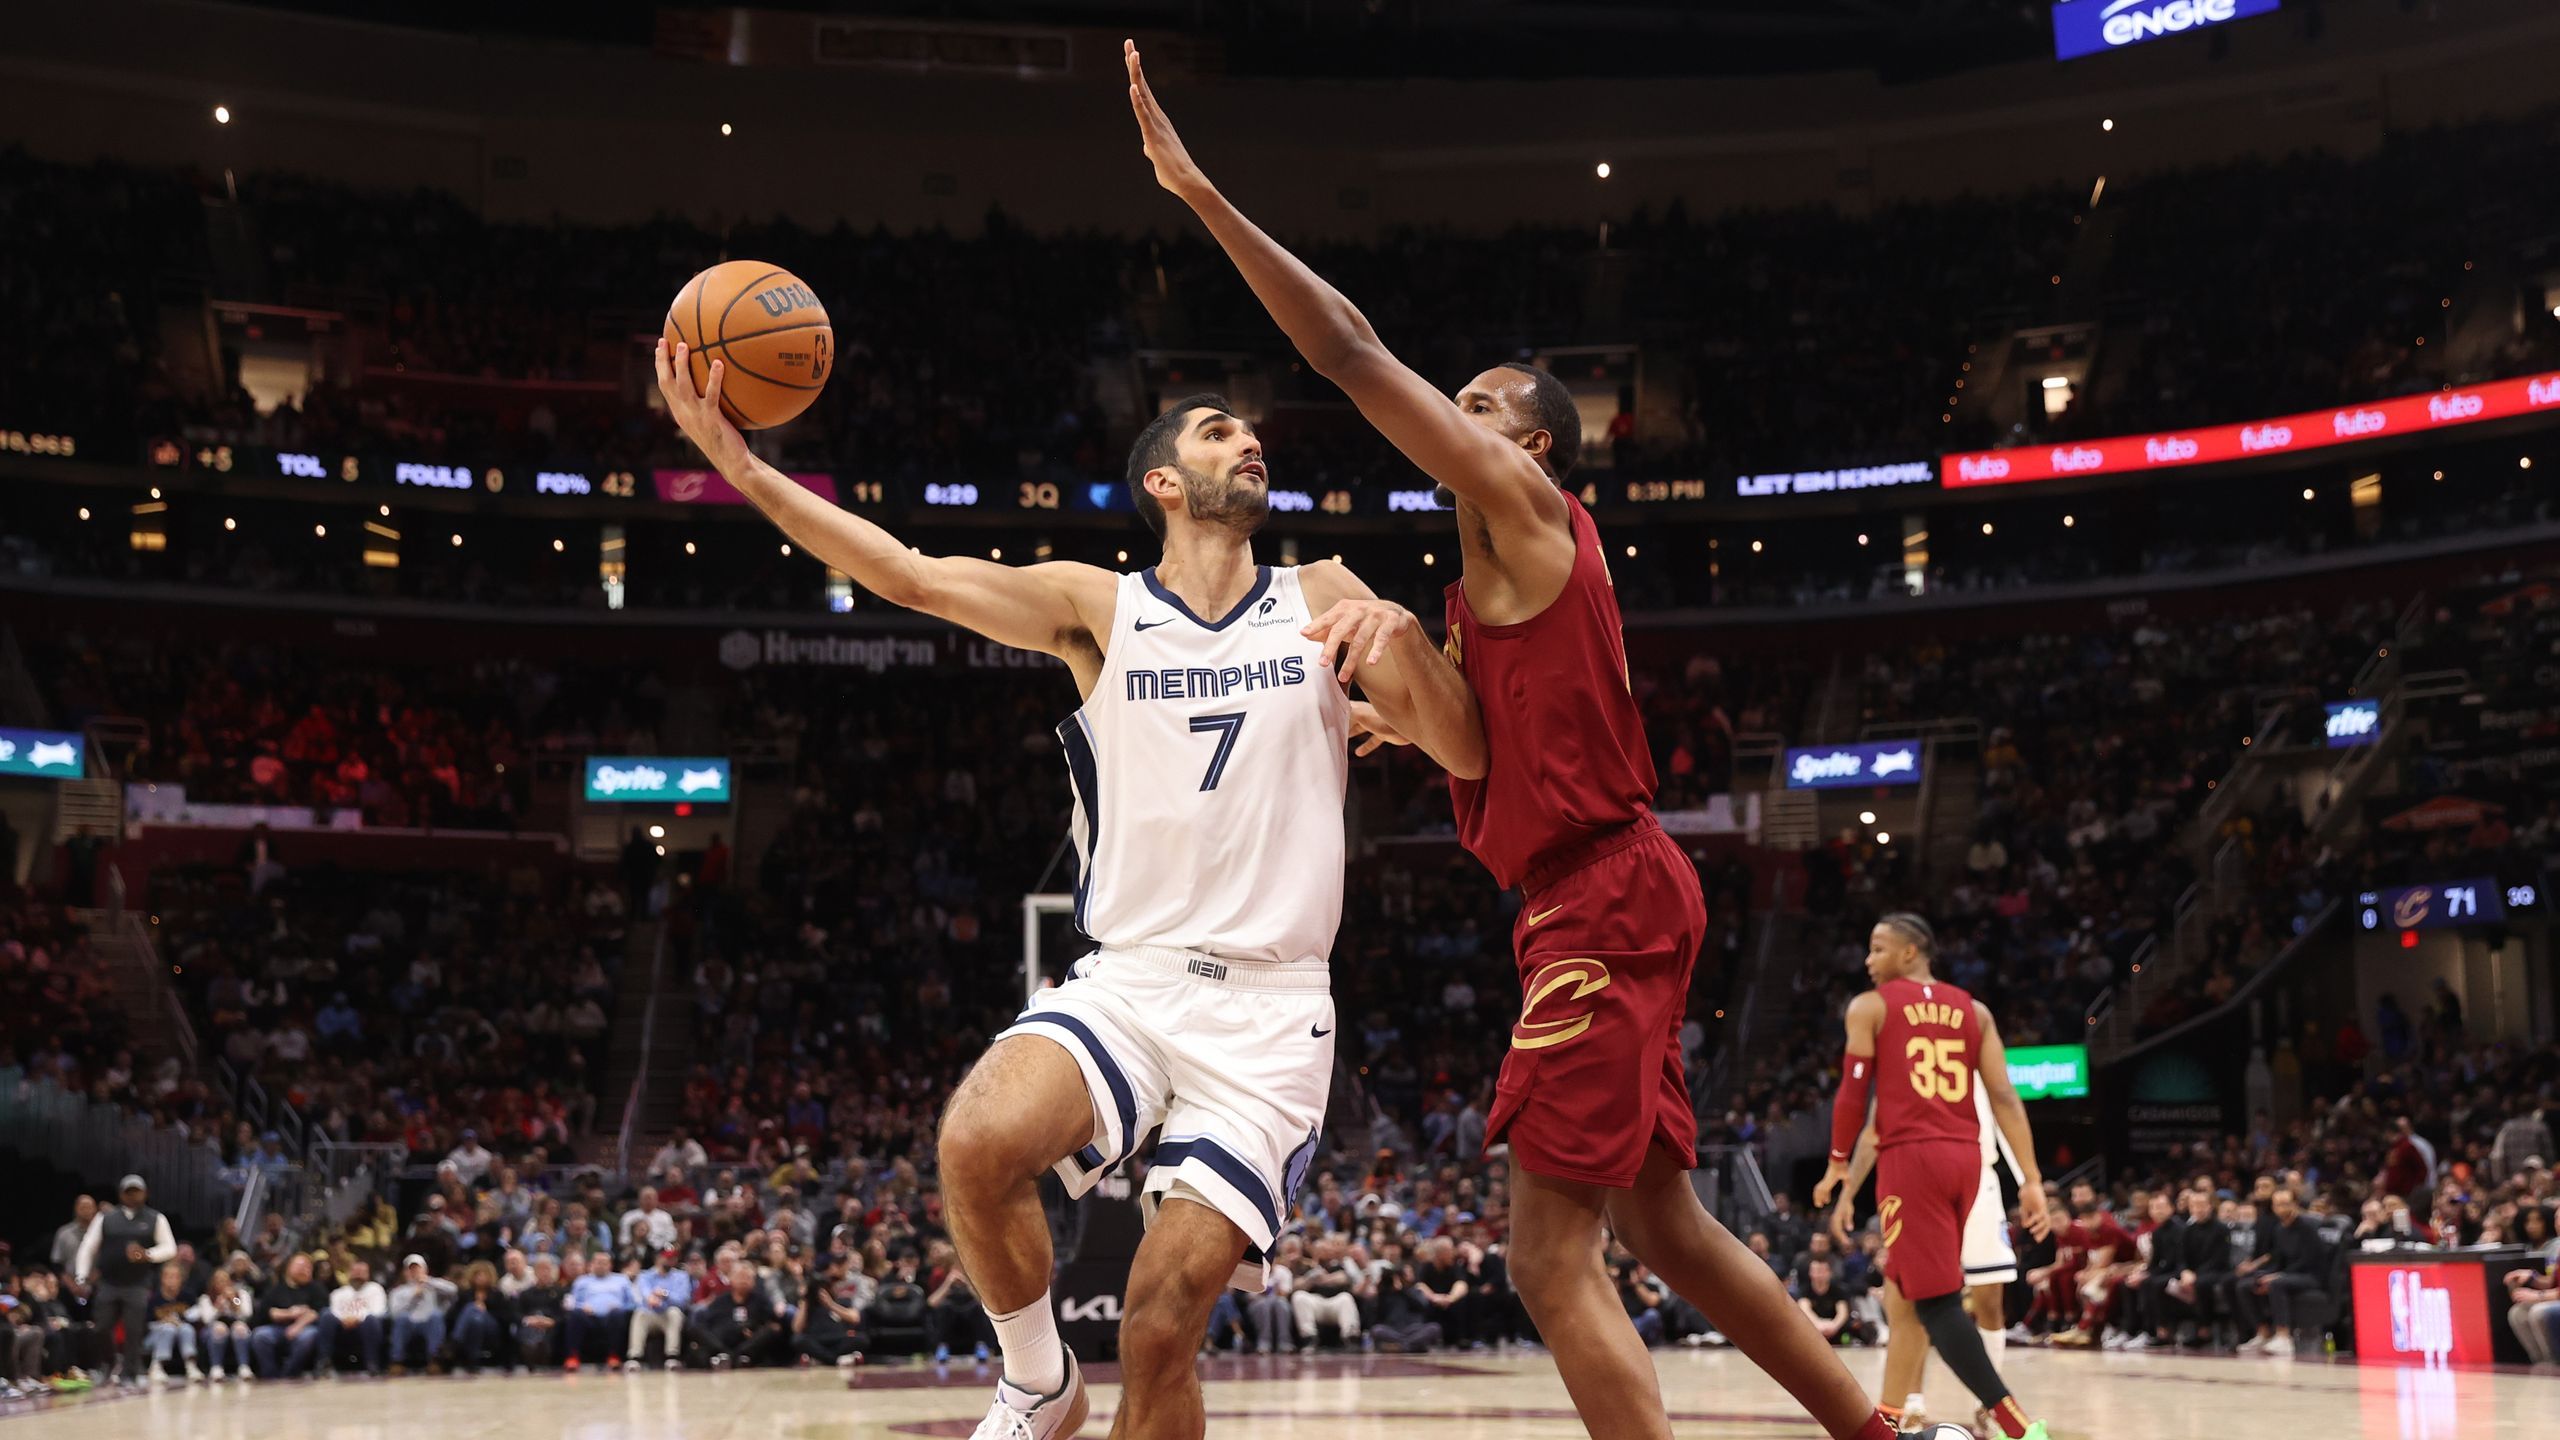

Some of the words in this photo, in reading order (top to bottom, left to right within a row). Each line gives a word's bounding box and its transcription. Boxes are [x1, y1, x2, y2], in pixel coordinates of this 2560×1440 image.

[276, 453, 327, 479] TOL
[395, 462, 473, 489] FOULS
[486, 467, 504, 493] 0
[536, 472, 591, 496] FG%
[601, 472, 635, 498] 42
[1019, 482, 1060, 509] 3Q
[1671, 479, 1705, 501] PM
[1737, 473, 1793, 496] LET
[1248, 616, 1294, 629] Robinhood
[1126, 656, 1306, 701] MEMPHIS
[1189, 711, 1247, 792] 7
[592, 765, 668, 796] Sprite
[1792, 752, 1862, 784] Sprite
[2444, 886, 2477, 918] 71
[2507, 885, 2536, 907] 3Q
[1904, 1002, 1964, 1030] OKORO
[1906, 1036, 1968, 1103] 35
